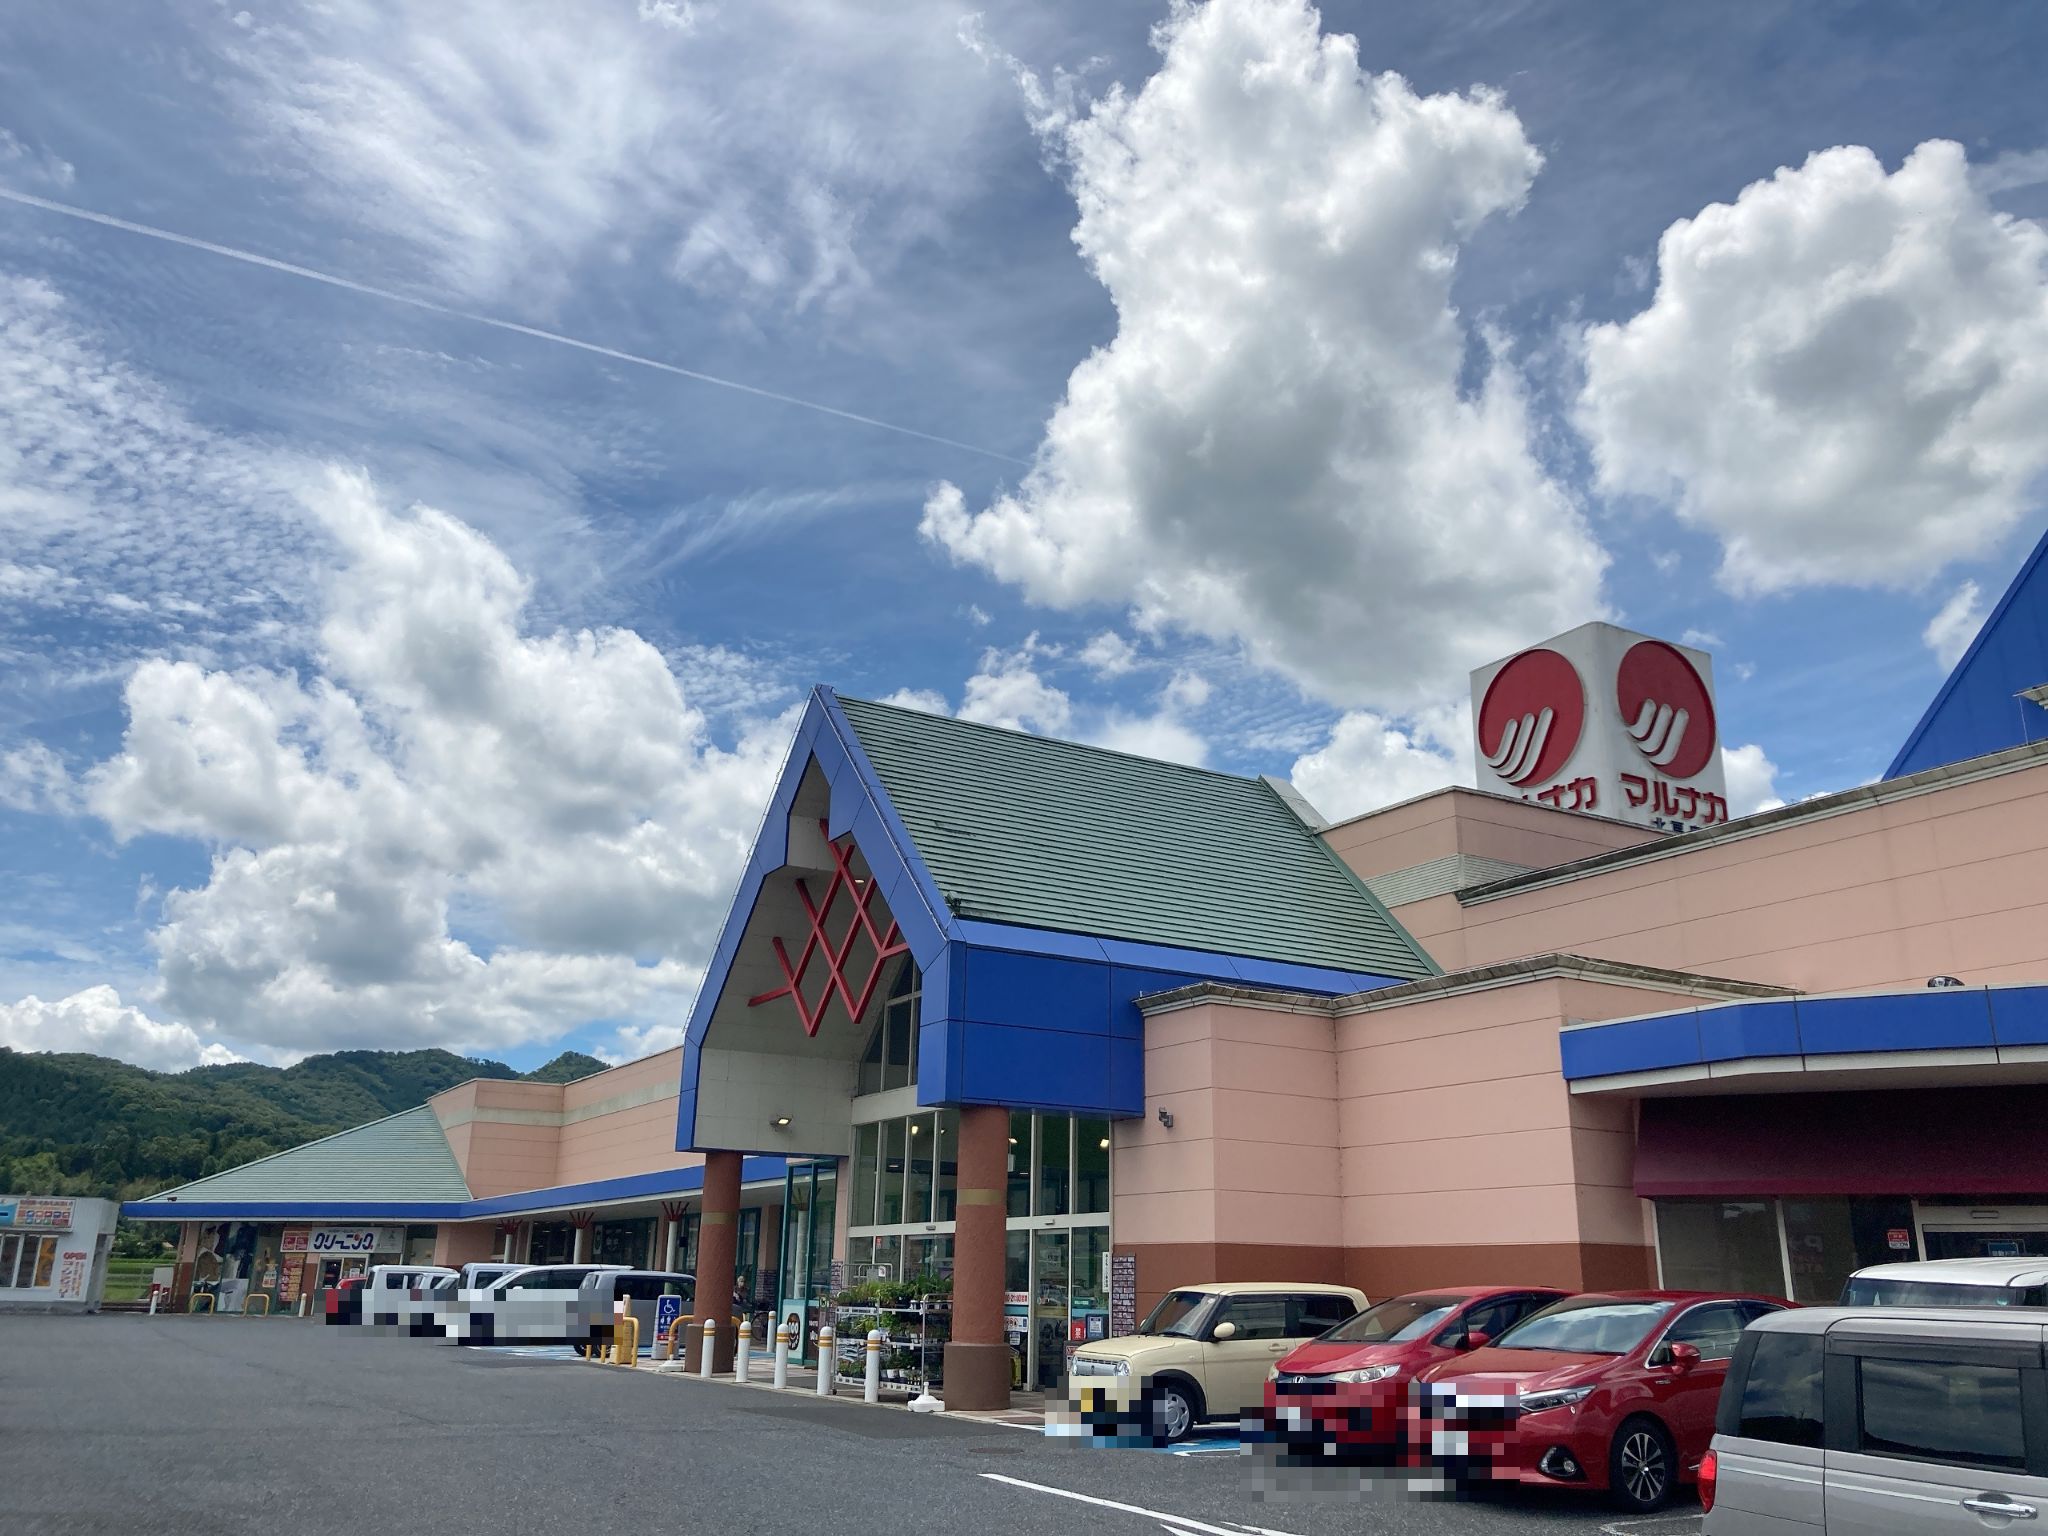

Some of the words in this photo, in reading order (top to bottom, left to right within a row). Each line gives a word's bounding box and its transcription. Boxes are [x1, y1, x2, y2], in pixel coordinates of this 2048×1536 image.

[1620, 773, 1728, 823] マルナカ
[313, 1232, 374, 1250] クリーニング
